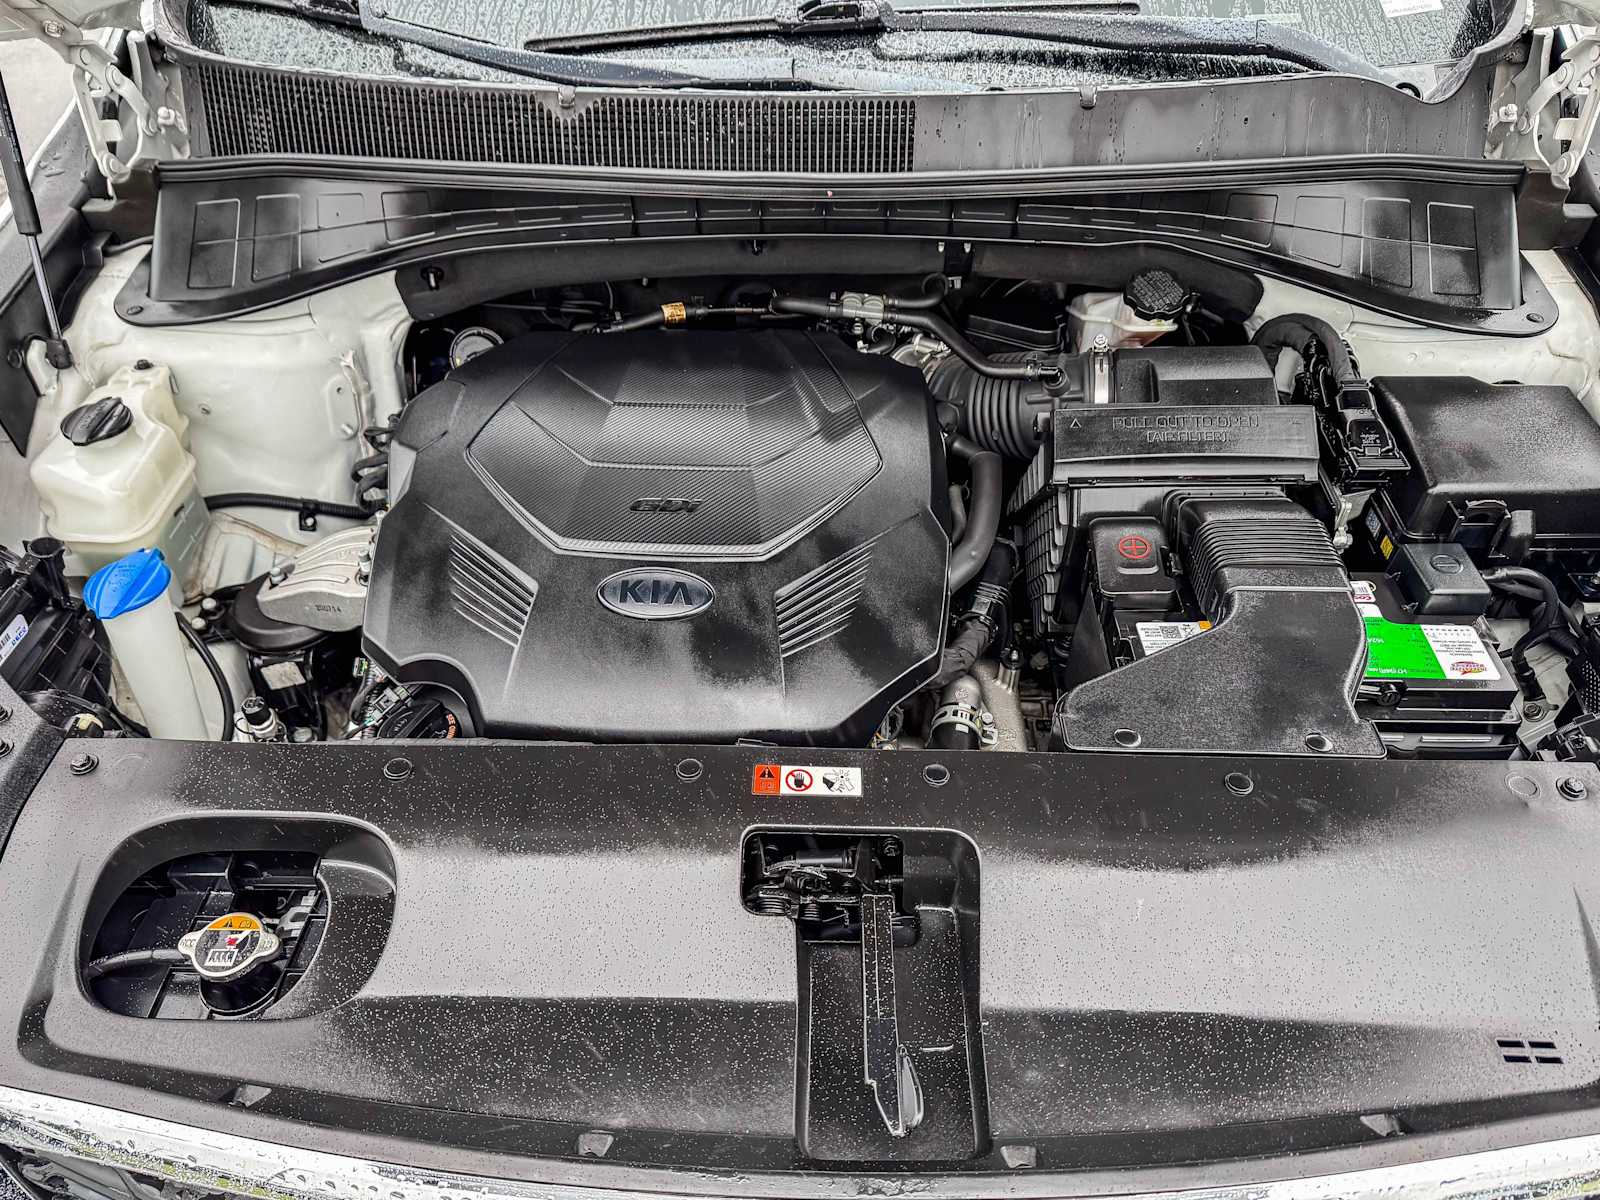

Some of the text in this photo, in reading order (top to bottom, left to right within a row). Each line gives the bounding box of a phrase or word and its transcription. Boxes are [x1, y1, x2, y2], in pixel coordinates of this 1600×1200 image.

[1112, 414, 1259, 429] PULL OUT TO OPEN
[619, 579, 694, 606] KIA
